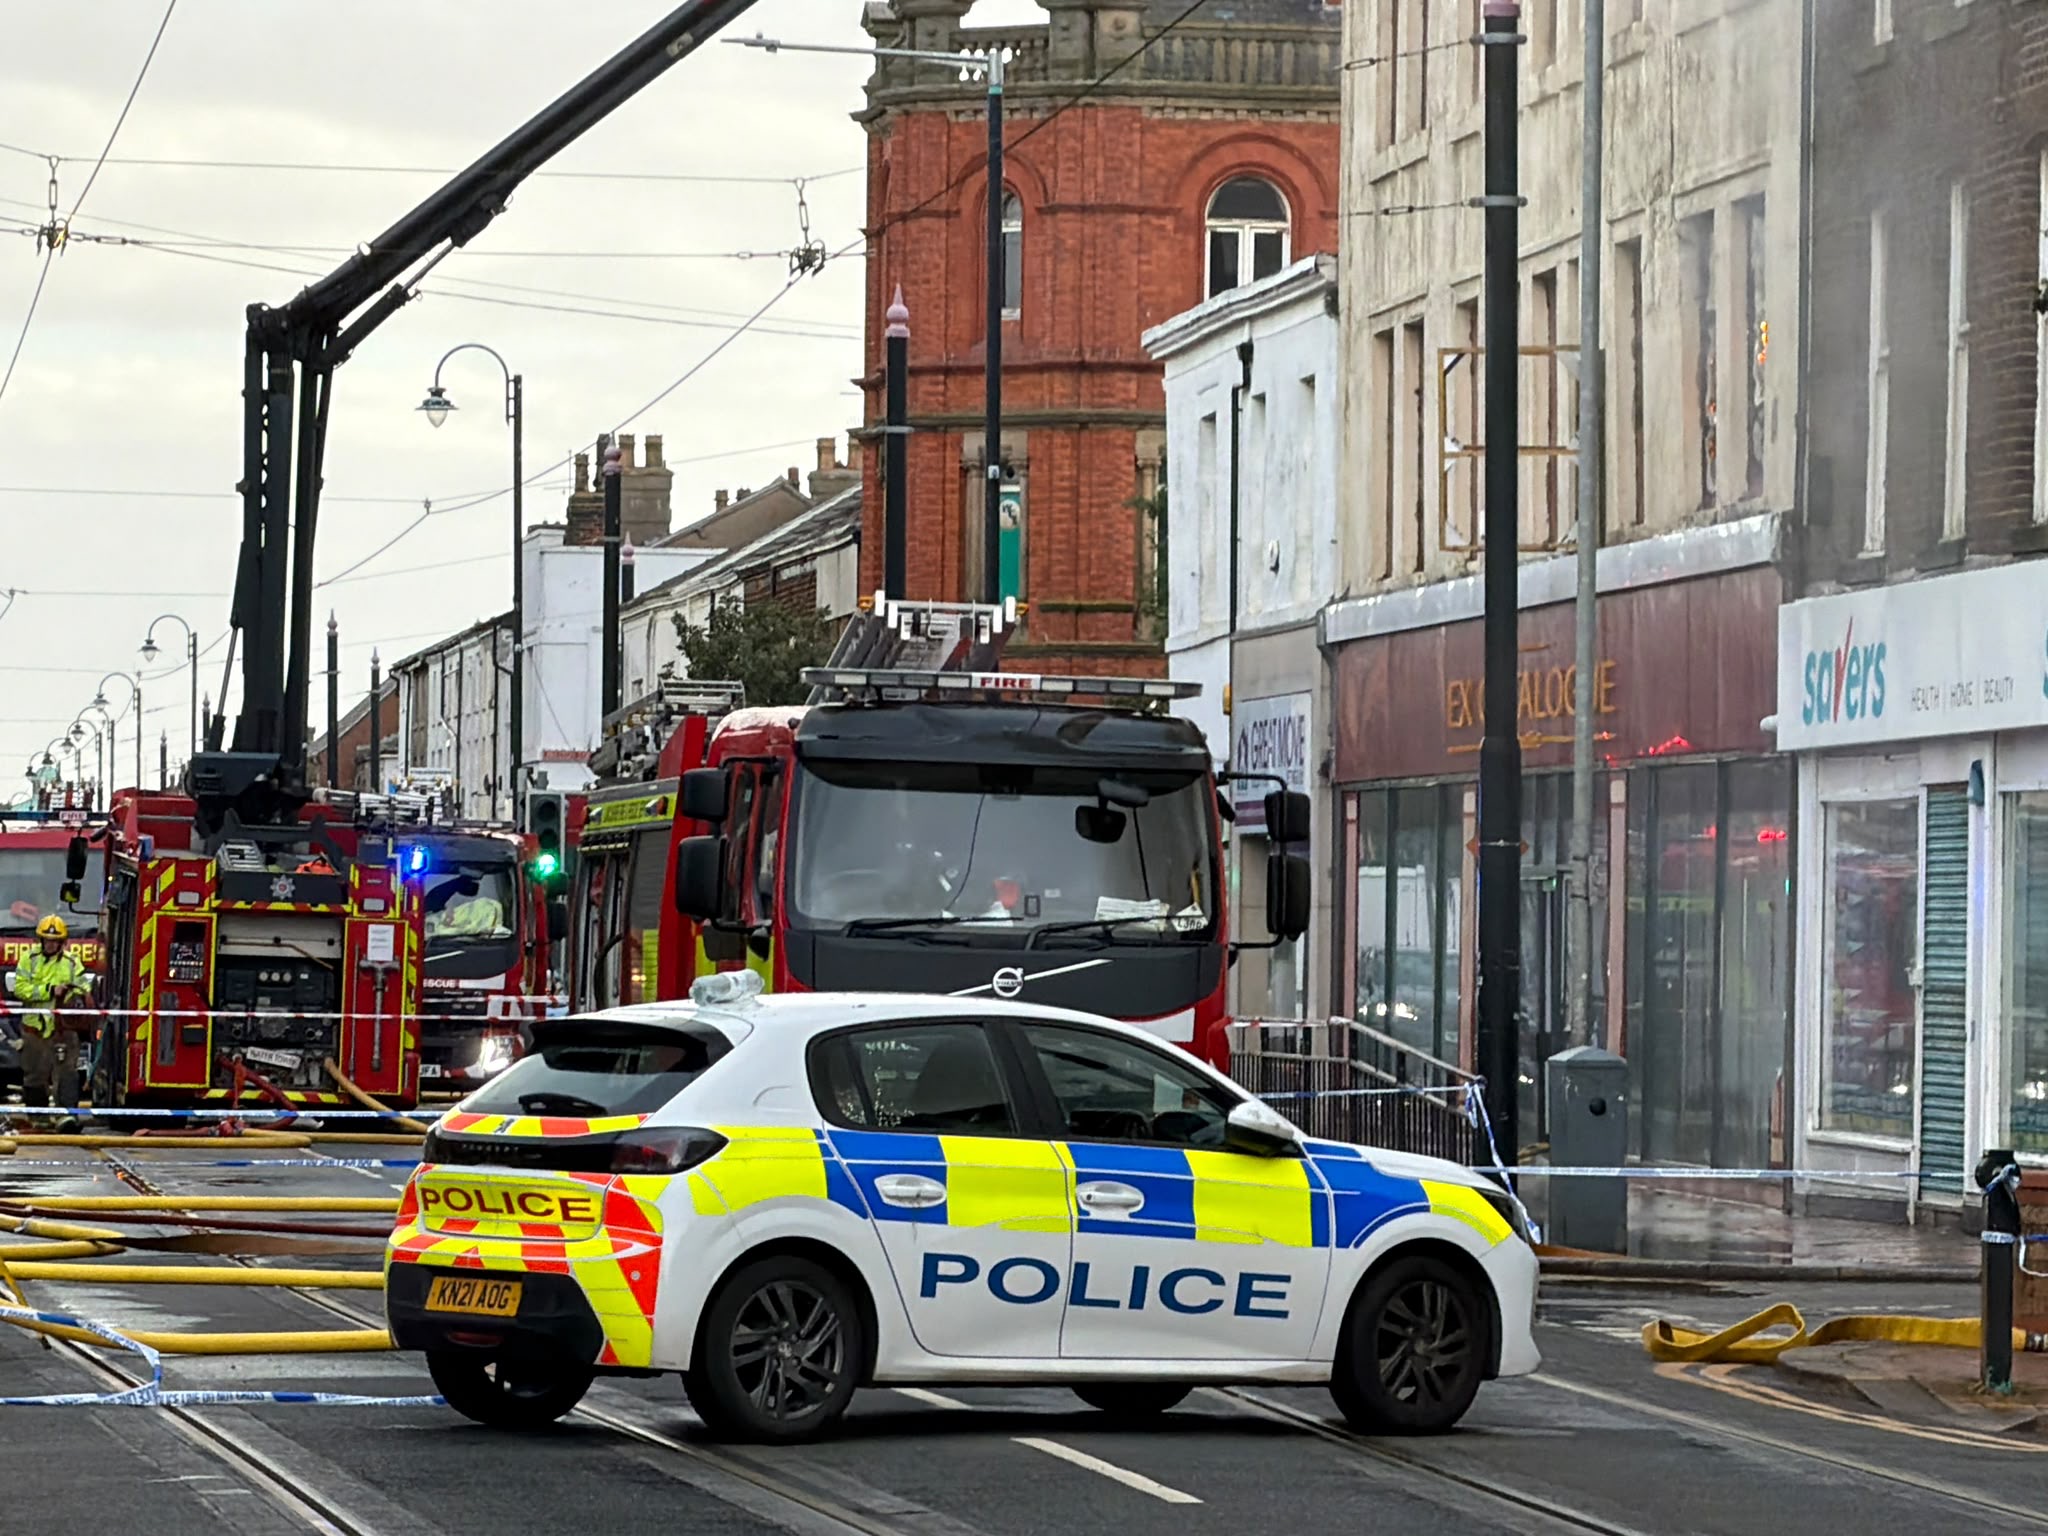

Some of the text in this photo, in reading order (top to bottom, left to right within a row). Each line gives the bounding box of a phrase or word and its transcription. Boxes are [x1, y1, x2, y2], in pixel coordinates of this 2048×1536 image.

[981, 677, 1033, 688] FIRE
[1803, 616, 1887, 726] savers
[1447, 679, 1473, 728] EX
[1911, 676, 2014, 712] HEALTH HOME BEAUTY
[420, 1187, 596, 1223] POLICE
[437, 1280, 512, 1310] KN21 AOG
[920, 1252, 1292, 1319] POLICE
